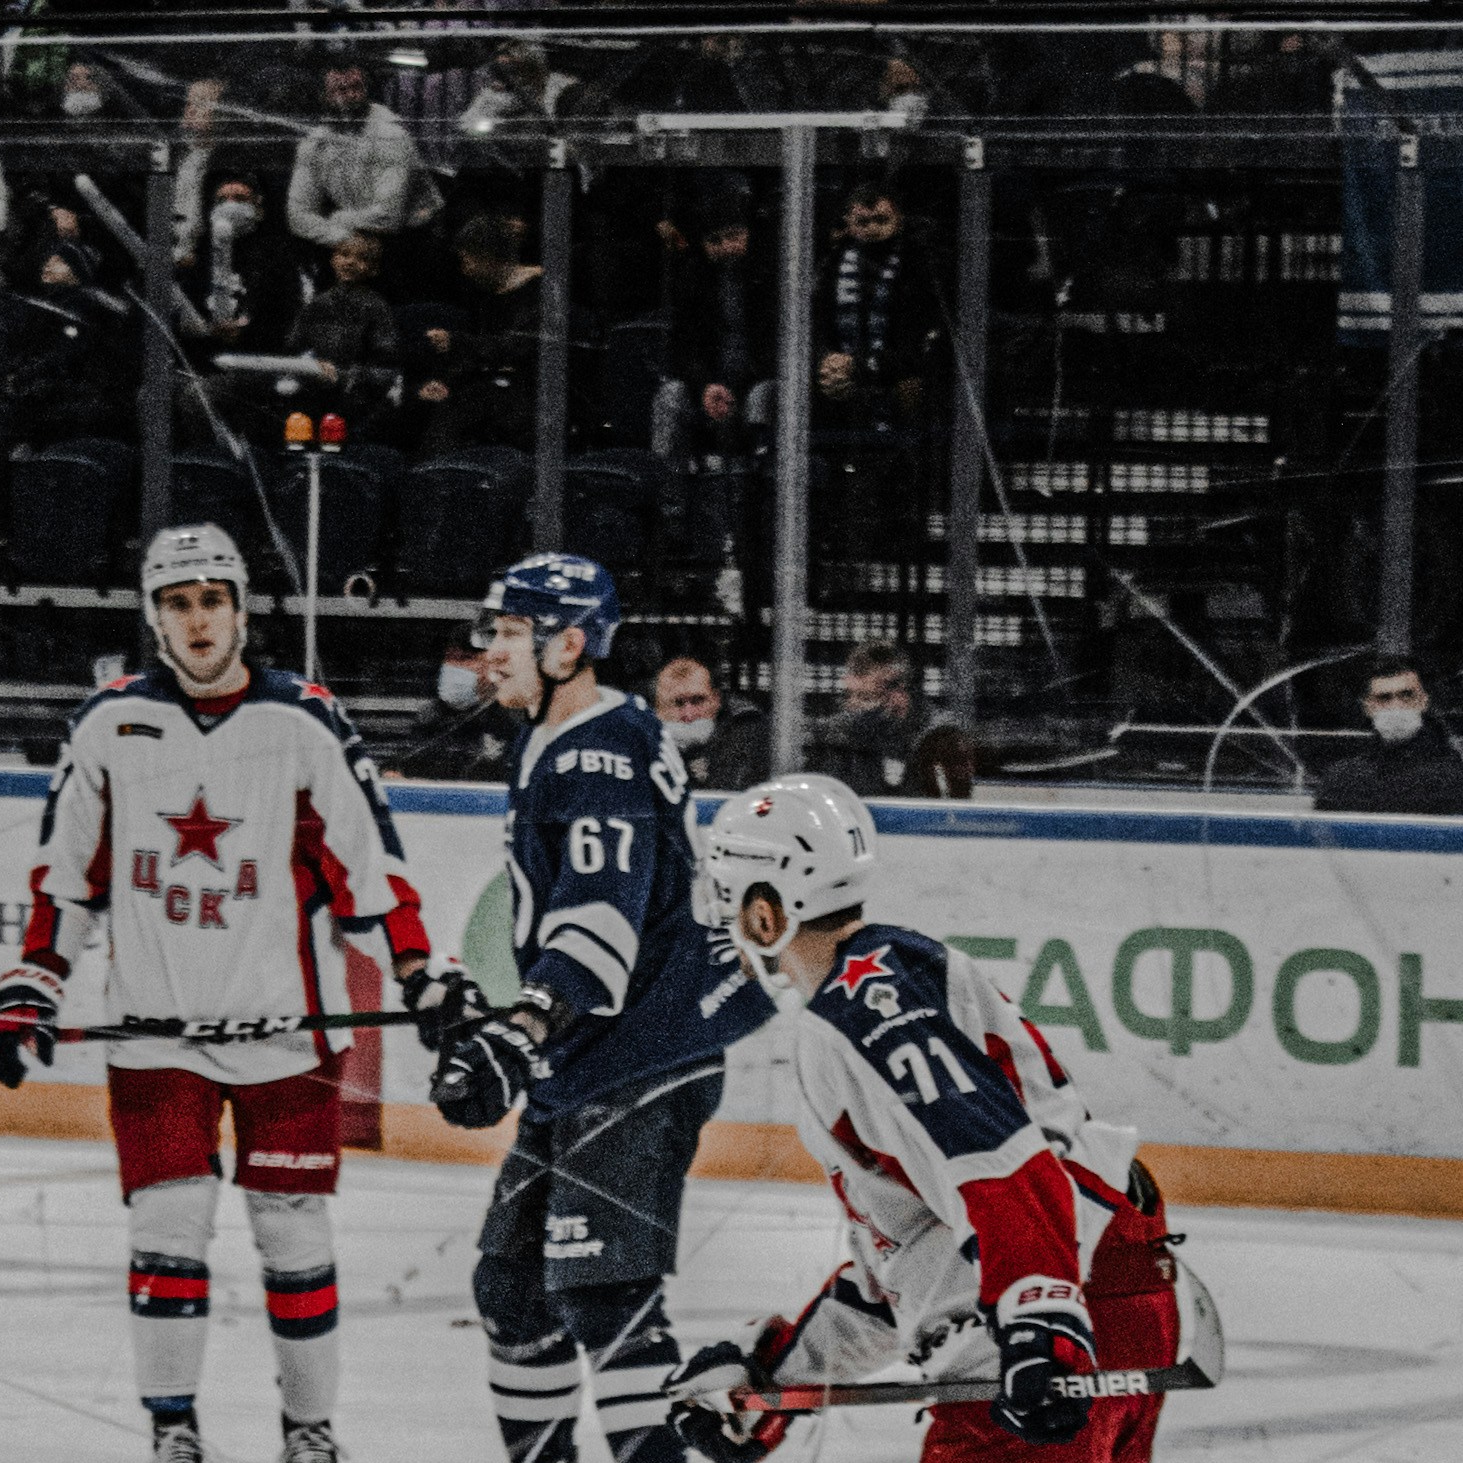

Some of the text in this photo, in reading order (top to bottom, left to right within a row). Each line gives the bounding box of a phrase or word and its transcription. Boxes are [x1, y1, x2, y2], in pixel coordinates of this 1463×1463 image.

[579, 749, 635, 781] ВТБ
[569, 815, 635, 875] 67
[847, 826, 866, 858] 71
[131, 848, 258, 929] ЦСКА
[886, 1036, 977, 1105] 71
